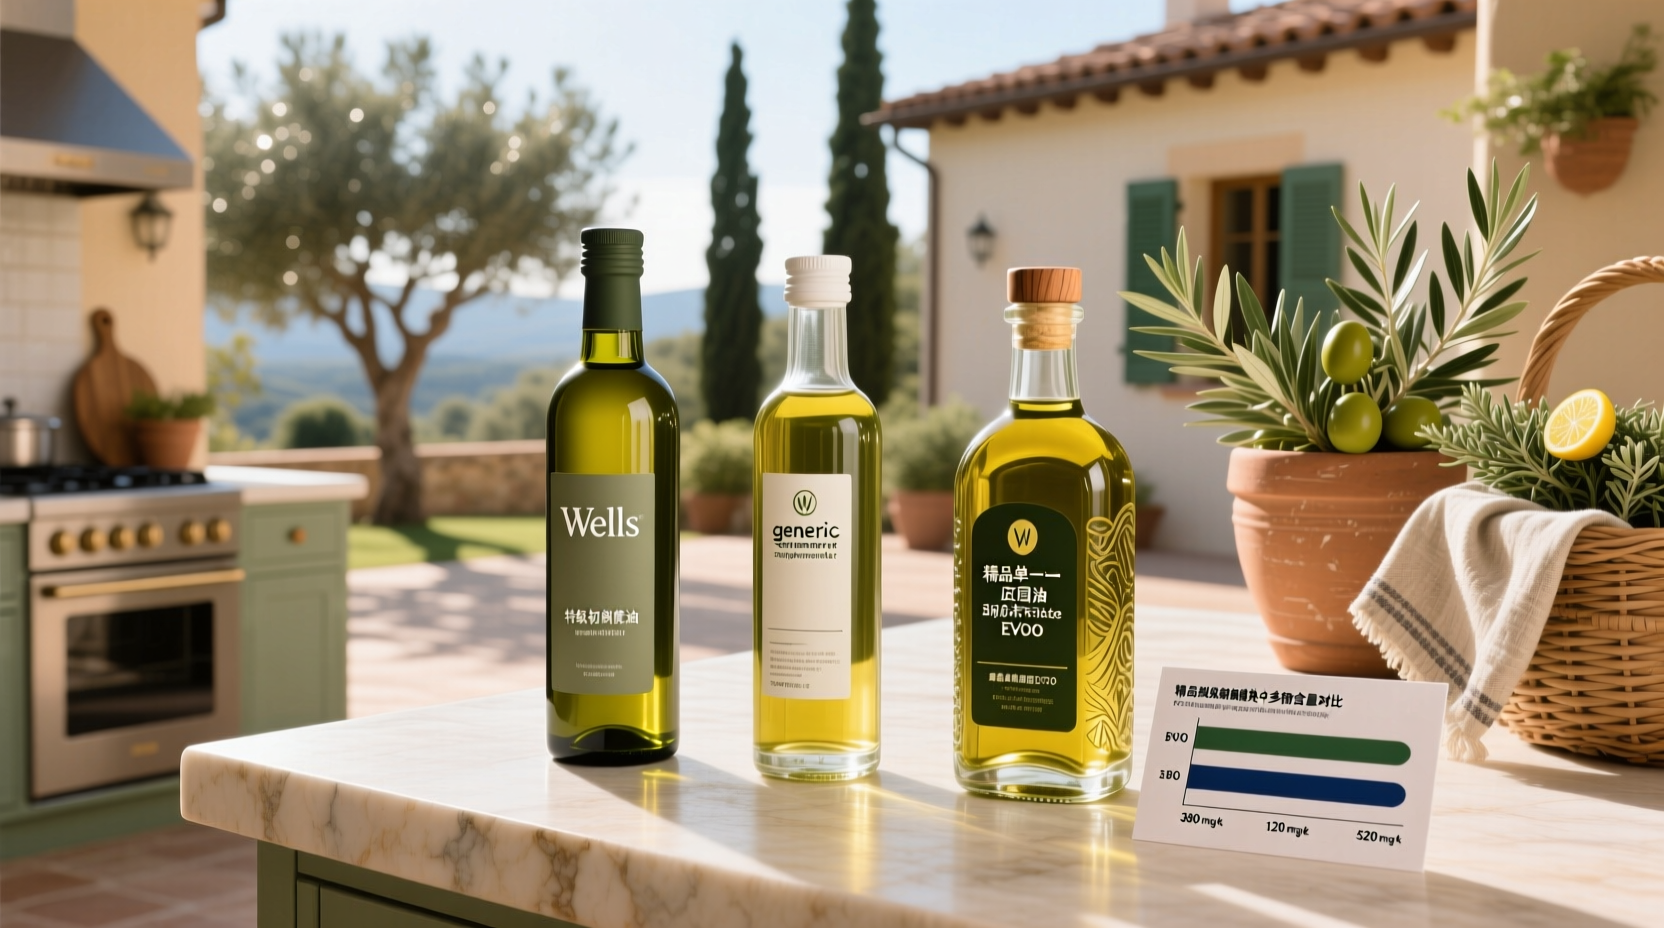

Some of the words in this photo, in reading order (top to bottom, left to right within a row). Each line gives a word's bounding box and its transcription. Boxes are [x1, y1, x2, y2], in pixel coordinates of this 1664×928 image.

[560, 506, 640, 538] Wells
[773, 521, 840, 542] generic
[1013, 527, 1031, 549] W
[1001, 621, 1044, 637] EVOO
[1266, 821, 1285, 833] 120
[1356, 829, 1378, 842] 520
